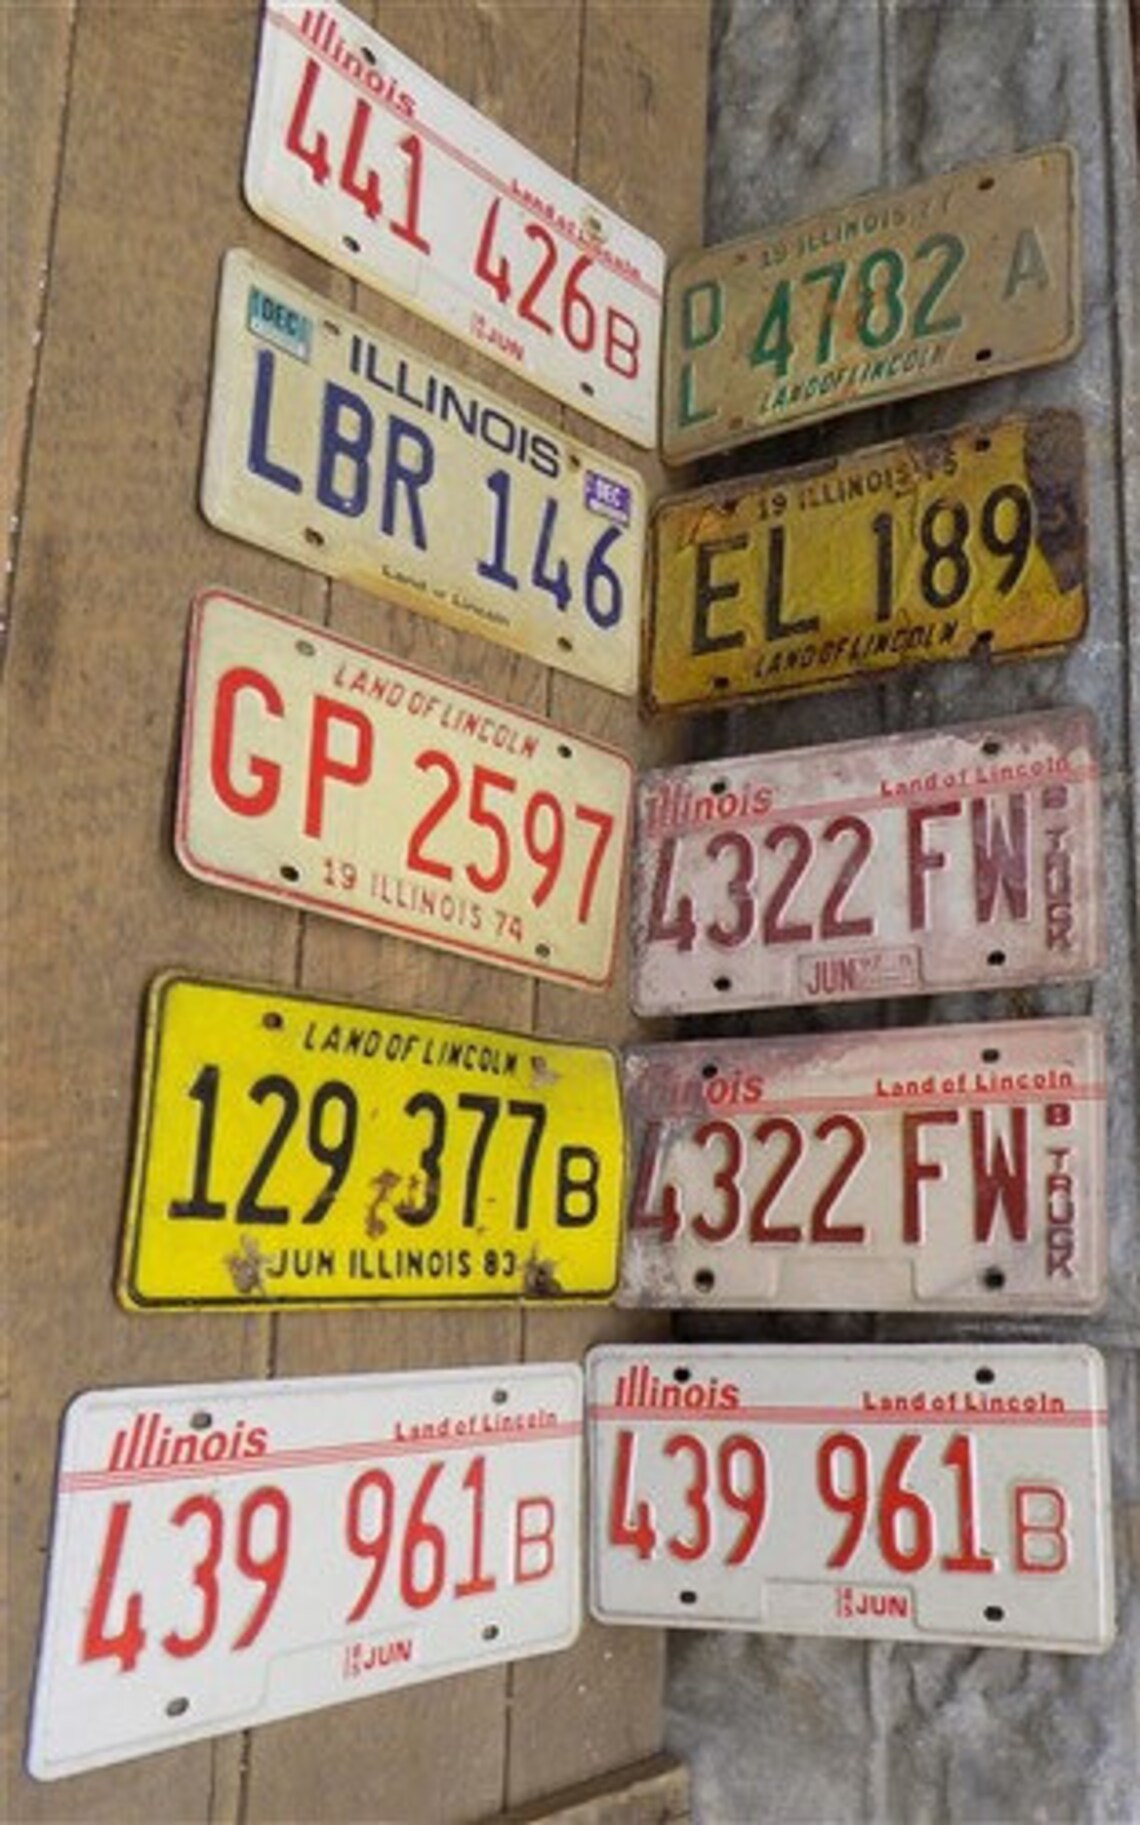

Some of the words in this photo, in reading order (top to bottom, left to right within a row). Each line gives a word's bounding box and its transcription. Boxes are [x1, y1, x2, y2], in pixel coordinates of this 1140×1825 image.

[299, 10, 417, 118] Illinois
[285, 58, 430, 256] 441
[474, 197, 597, 353] 426
[604, 306, 640, 380] B
[801, 207, 912, 254] ILLINOIS
[261, 297, 299, 335] DEC
[750, 232, 967, 378] 4782
[1003, 226, 1051, 301] A
[350, 334, 560, 480] ILLINOIS
[247, 349, 434, 551] LBR
[476, 468, 624, 629] 146
[596, 477, 622, 507] DEC
[759, 491, 787, 520] 19
[800, 466, 913, 511] ILLINOIS
[381, 564, 427, 591] Land
[691, 525, 820, 655] EL
[872, 483, 1034, 623] 189
[333, 664, 411, 709] LAND
[407, 688, 435, 717] OF
[440, 703, 539, 759] LINCOLN
[210, 665, 374, 840] GP
[406, 749, 615, 925] 2597
[645, 781, 773, 837] Illinois
[879, 772, 937, 798] Land
[943, 768, 967, 788] of
[974, 756, 1070, 785] Lincoln
[322, 857, 357, 890] 19
[370, 873, 482, 931] ILLINOIS
[494, 910, 523, 944] 74
[647, 815, 875, 953] 4322
[905, 793, 1030, 933] FW
[806, 957, 855, 995] JUN
[304, 1020, 379, 1060] LAND
[384, 1033, 418, 1063] OF
[421, 1039, 518, 1076] LINCOLN
[876, 1074, 934, 1098] Land
[942, 1073, 967, 1094] of
[974, 1070, 1073, 1094] Lincoln
[167, 1064, 358, 1225] 129
[394, 1091, 548, 1231] 377
[555, 1145, 600, 1228] B
[1044, 1102, 1073, 1128] B
[629, 1114, 867, 1245] 4322
[902, 1106, 1029, 1244] FW
[1045, 1147, 1076, 1280] TRUCK
[266, 1249, 336, 1281] JUN
[348, 1249, 472, 1280] ILLINOIS
[483, 1248, 518, 1279] 83
[615, 1365, 741, 1410] Illinois
[862, 1391, 926, 1412] Land
[931, 1391, 957, 1411] of
[965, 1391, 1066, 1414] Lincoln
[107, 1411, 269, 1472] Illinois
[395, 1416, 449, 1442] Land
[455, 1413, 477, 1436] of
[483, 1408, 558, 1433] Lincoln
[607, 1429, 768, 1567] 439
[816, 1430, 998, 1574] 961
[1011, 1482, 1070, 1574] B
[79, 1485, 292, 1674] 439
[345, 1454, 497, 1626] 961
[513, 1496, 555, 1584] B
[855, 1594, 908, 1619] JUN
[364, 1639, 413, 1670] JUN
